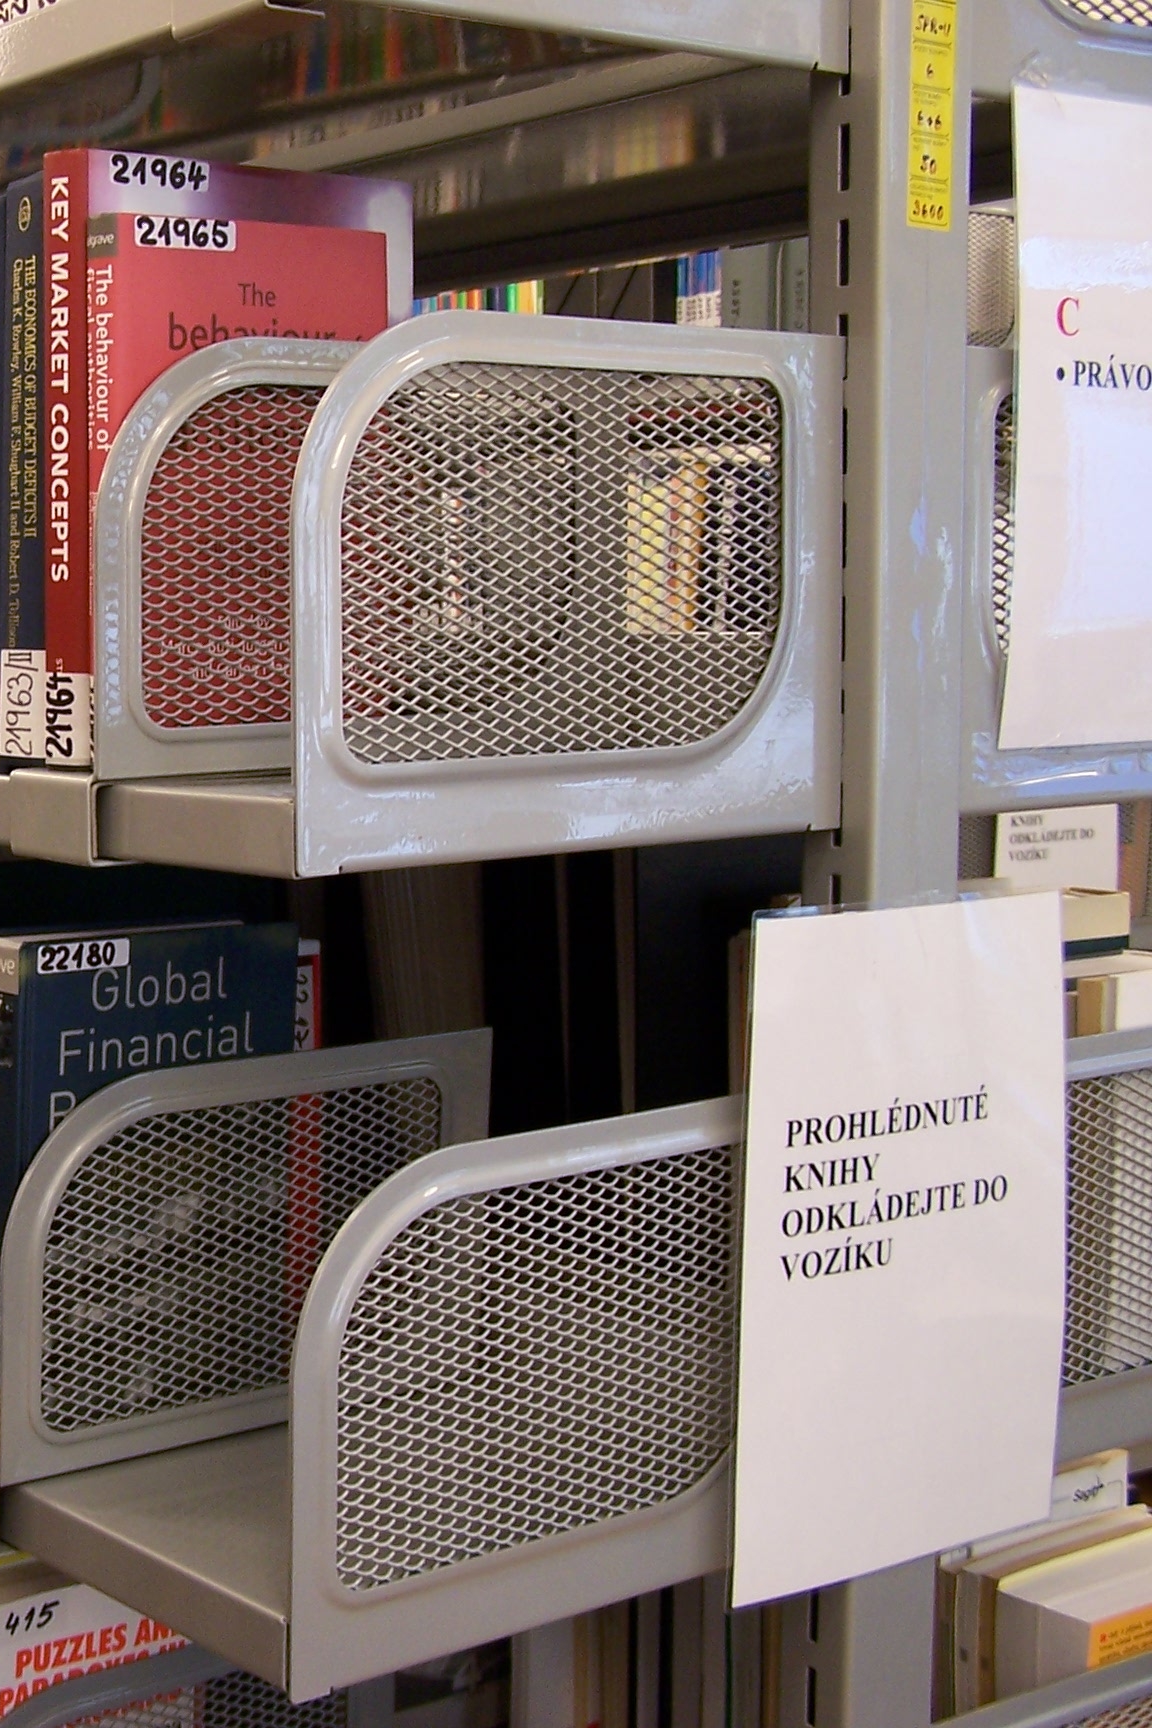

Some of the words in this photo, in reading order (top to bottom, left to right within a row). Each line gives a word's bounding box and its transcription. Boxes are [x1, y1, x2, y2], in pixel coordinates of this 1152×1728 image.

[111, 153, 207, 191] 21964
[51, 177, 69, 242] KEY
[136, 215, 230, 248] 21965
[10, 259, 22, 305] Charles
[24, 255, 36, 286] THE
[96, 264, 113, 306] The
[238, 282, 277, 307] The
[1056, 297, 1080, 336] C
[24, 290, 36, 372] ECONOMICS
[51, 253, 69, 394] MARKET
[24, 374, 36, 393] OF
[96, 313, 113, 423] behaviour
[1073, 354, 1152, 391] PRÁVO
[10, 375, 22, 423] William
[24, 397, 36, 455] BUDGET
[96, 429, 113, 451] of
[24, 459, 36, 525] DEFICITS
[51, 403, 69, 583] CONCEPTS
[10, 513, 22, 537] and
[24, 528, 36, 538] II
[4, 651, 38, 755] 21963/II
[46, 672, 74, 758] 21964
[40, 942, 115, 971] 22180
[92, 956, 227, 1012] Global
[59, 1011, 254, 1076] Financial
[785, 1084, 988, 1148] PROHLÉDNUTÉ
[783, 1153, 881, 1193] KNIHY
[781, 1188, 966, 1238] ODKLÁDEJTE
[973, 1175, 1008, 1206] DO
[779, 1236, 893, 1282] VOZÍKU
[15, 1624, 127, 1679] PUZZLES
